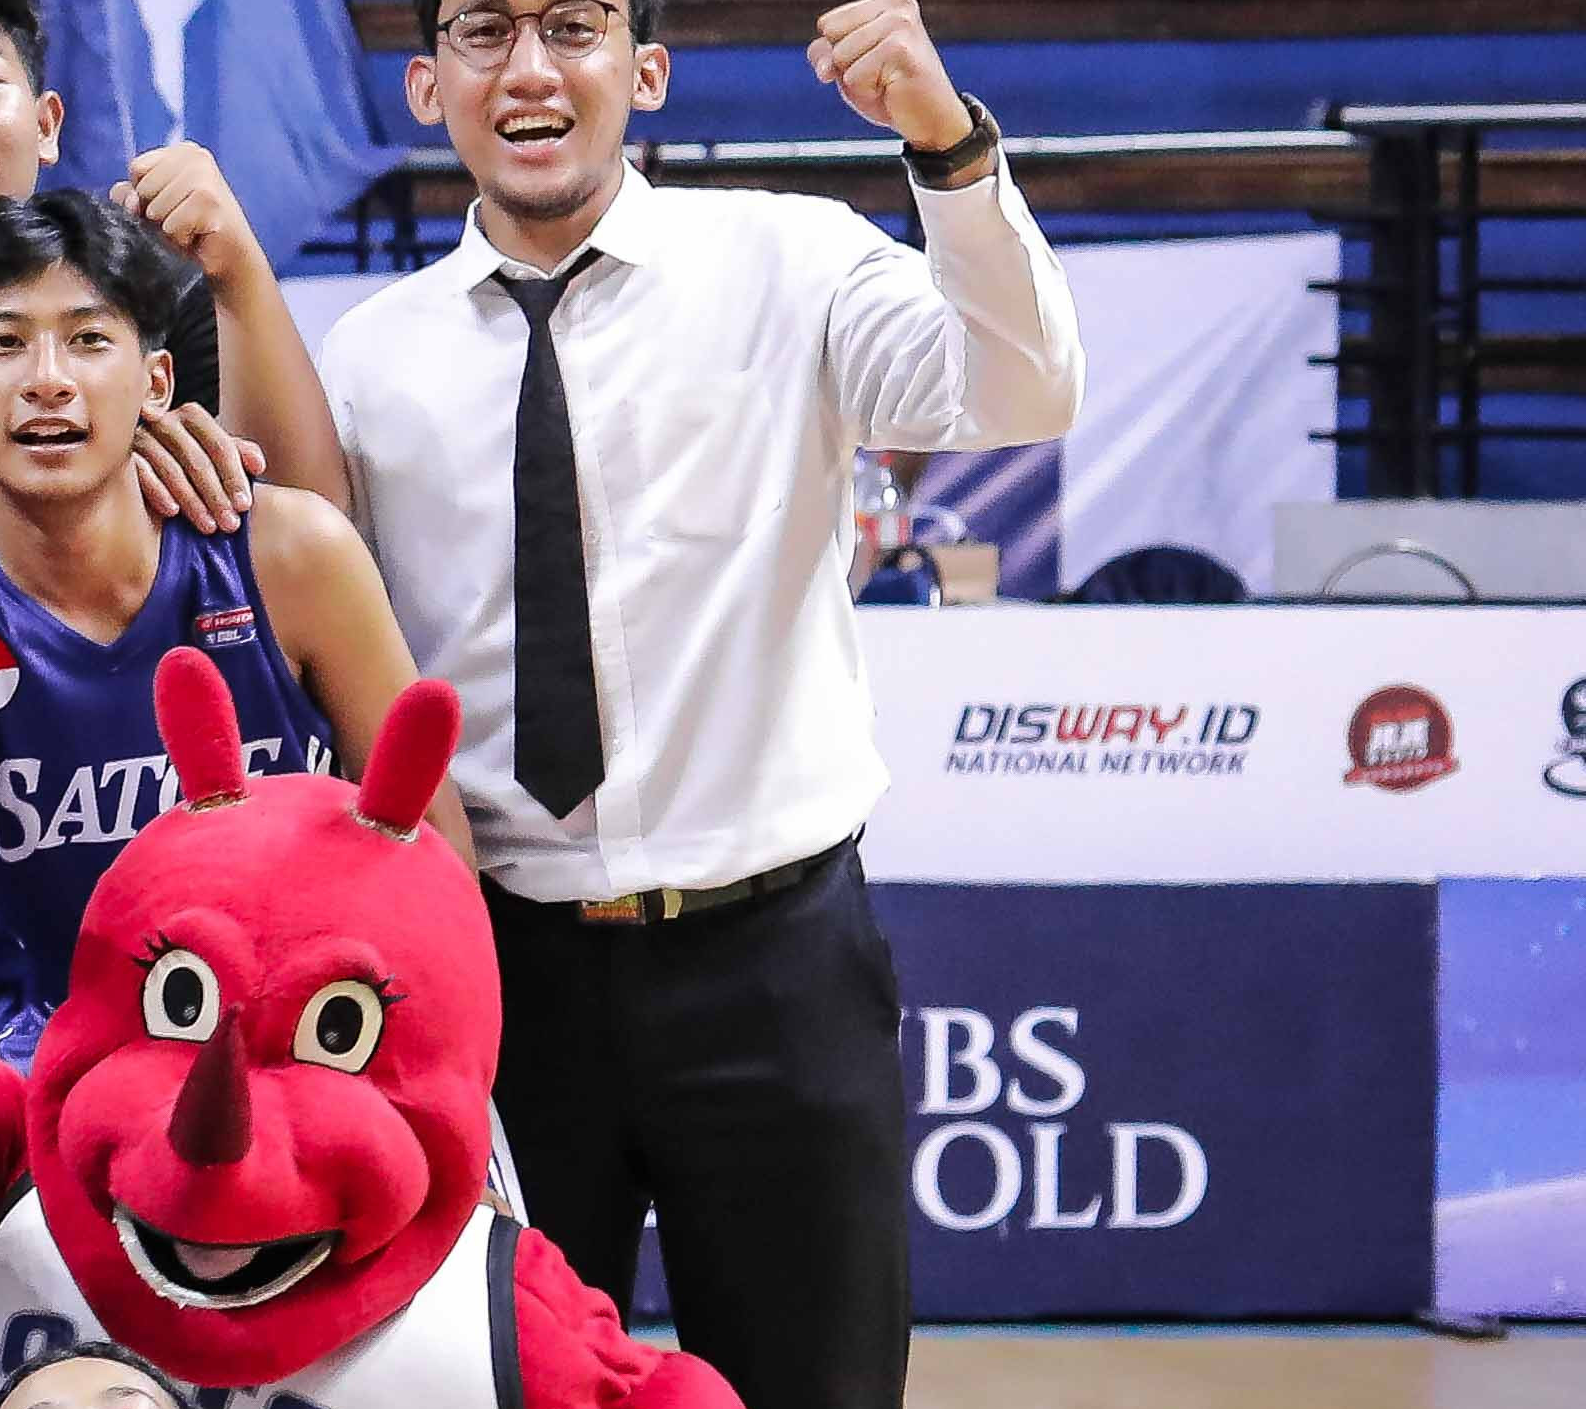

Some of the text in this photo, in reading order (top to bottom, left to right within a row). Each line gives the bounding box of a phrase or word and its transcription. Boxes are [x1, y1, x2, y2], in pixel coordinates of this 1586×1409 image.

[954, 703, 1261, 746] DISWAY.ID
[945, 750, 1246, 777] NATIONAL NETWORK
[898, 1006, 1087, 1116] BS
[912, 1121, 1209, 1231] OLD
